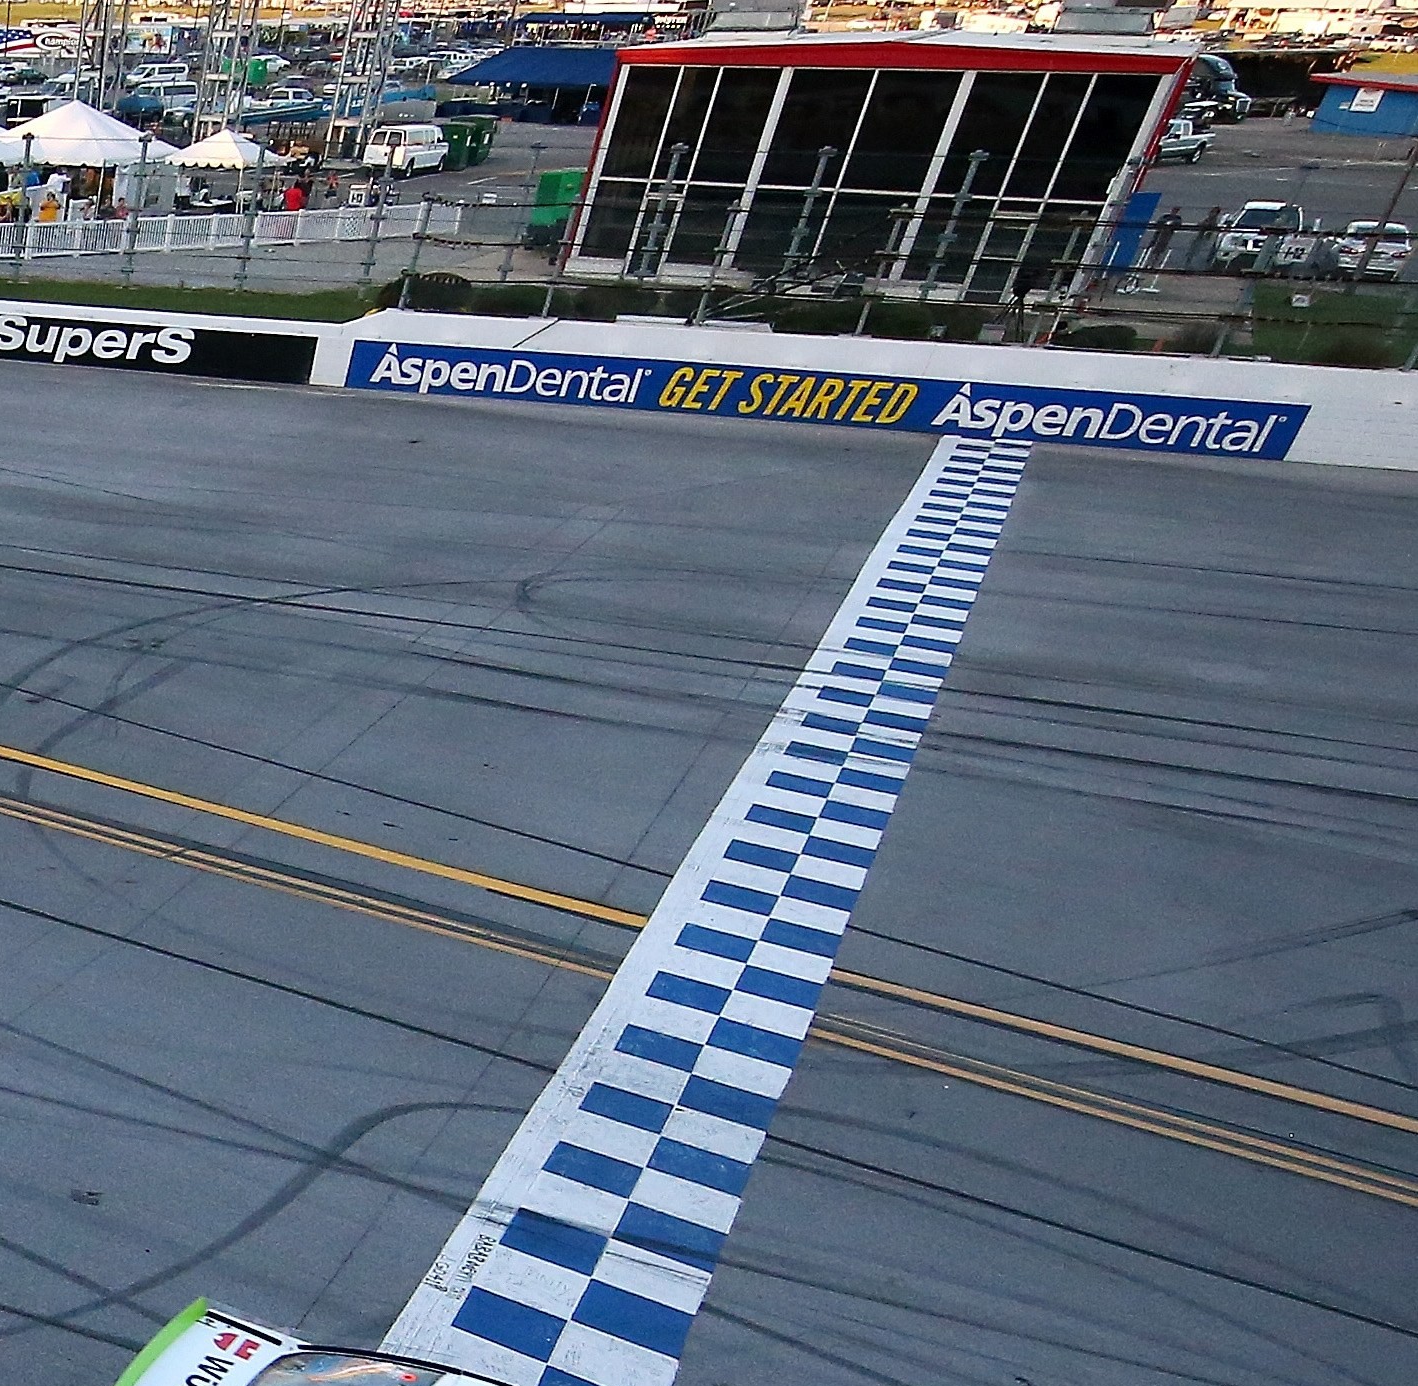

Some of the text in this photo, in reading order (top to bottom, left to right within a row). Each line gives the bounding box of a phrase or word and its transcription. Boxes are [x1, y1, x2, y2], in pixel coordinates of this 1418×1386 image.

[369, 343, 1281, 455] AspenDental GET STARTED AspenDental
